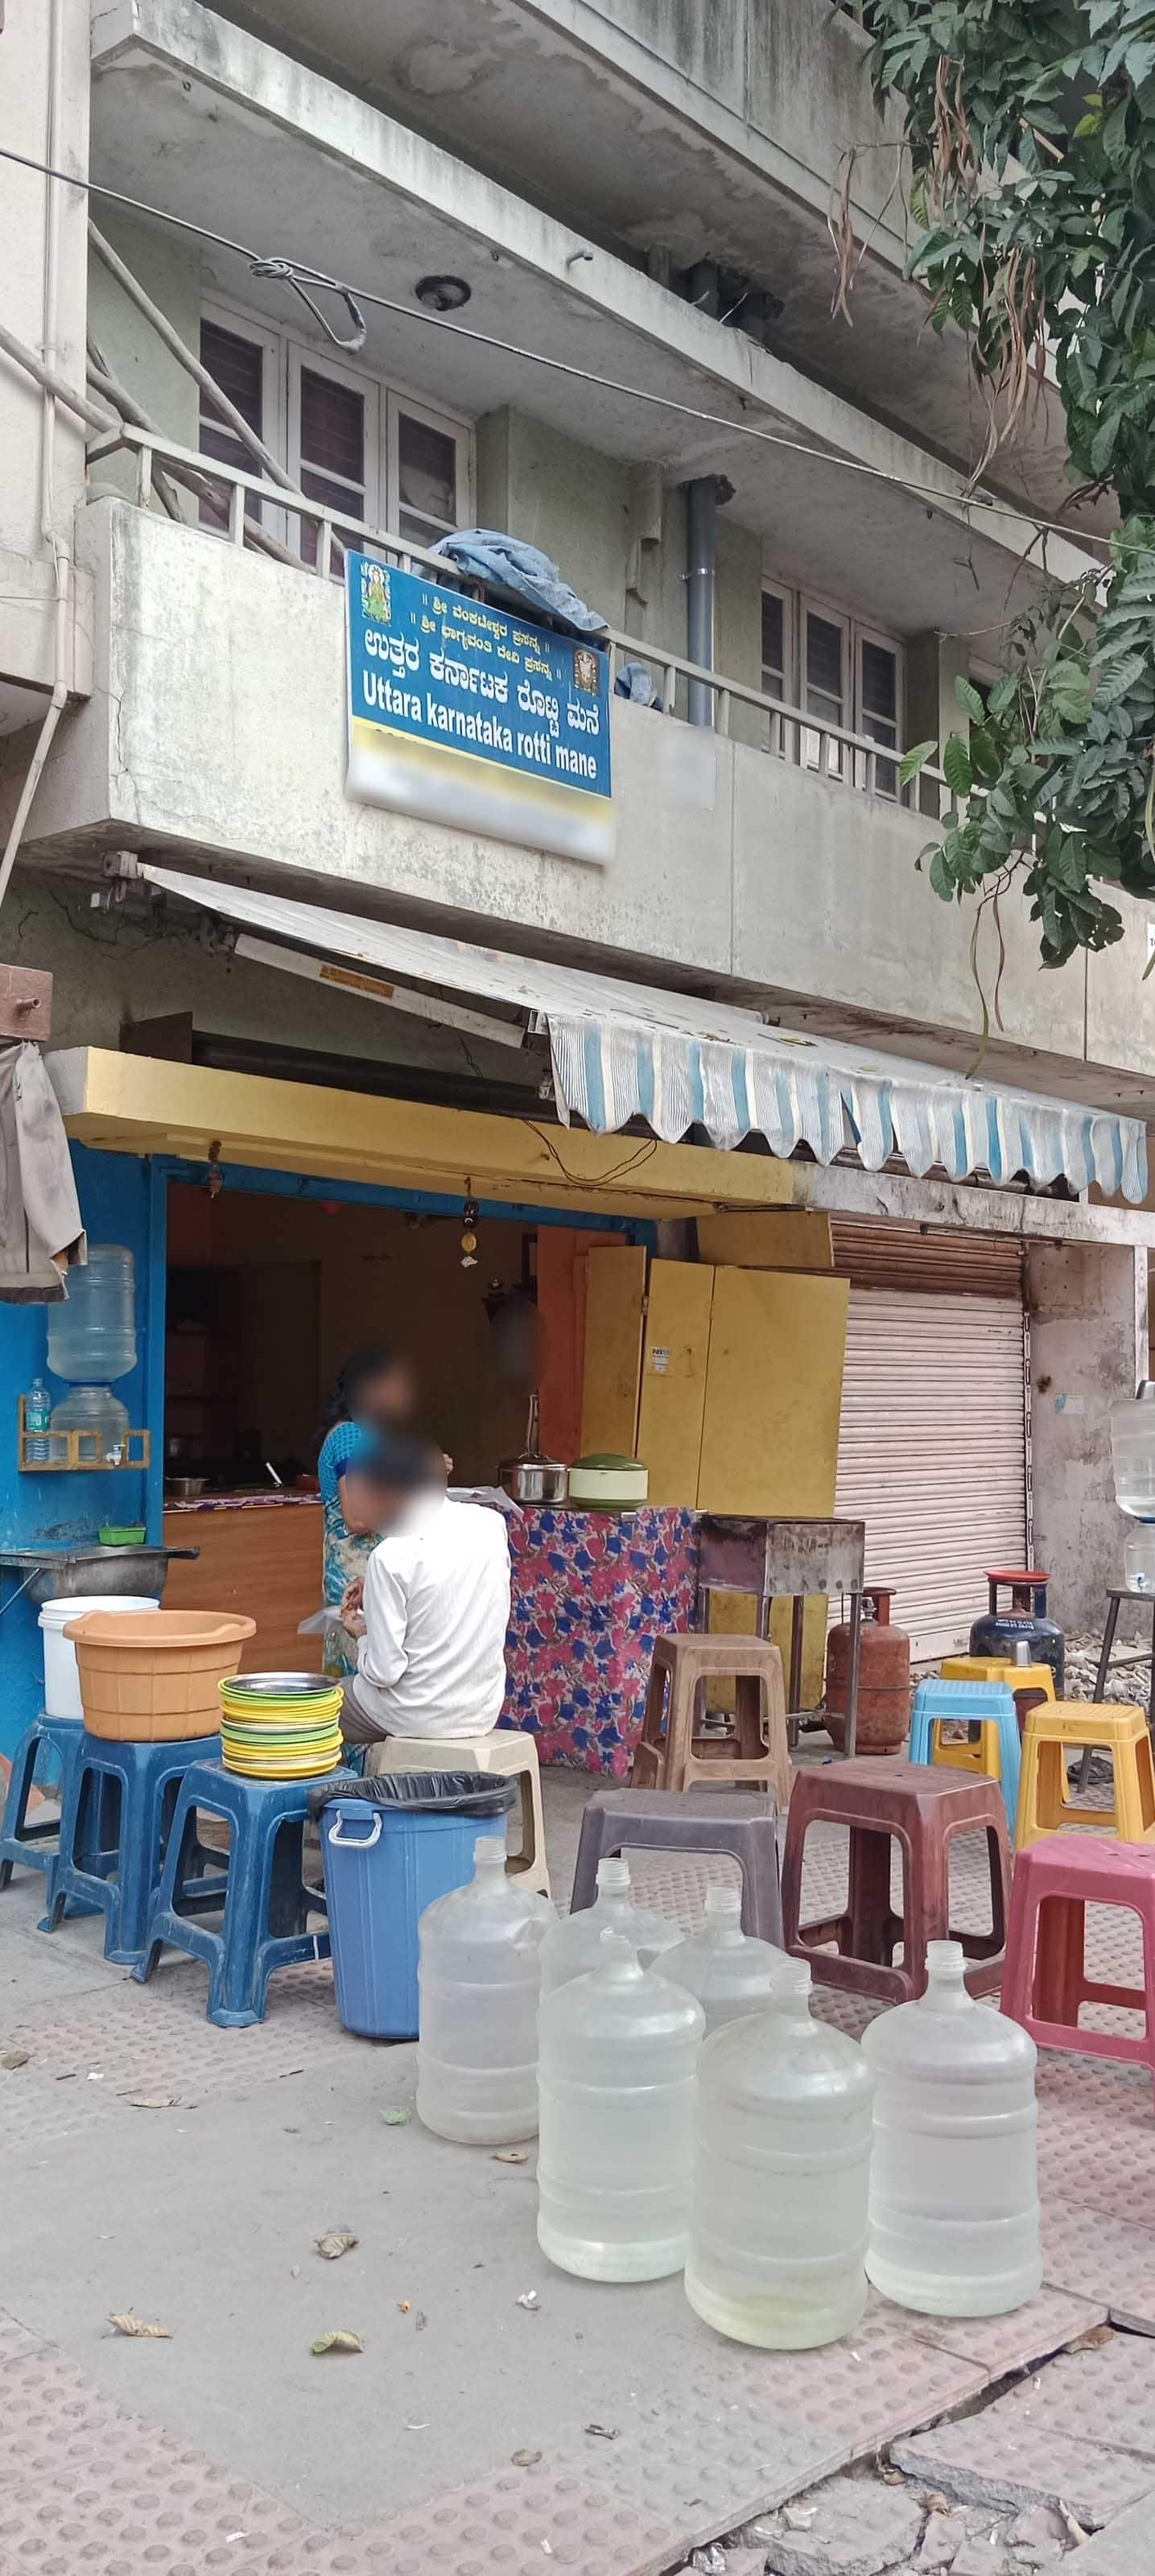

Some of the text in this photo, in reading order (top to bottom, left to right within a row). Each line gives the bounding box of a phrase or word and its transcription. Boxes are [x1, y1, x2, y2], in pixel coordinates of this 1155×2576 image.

[421, 615, 436, 634] ಶ್ರೀ
[497, 646, 520, 664] ದೇವಿ
[525, 656, 553, 681] ಪ್ರಸನ್ನ
[432, 597, 448, 614] ಶ್ರೀ
[452, 605, 508, 639] ವೆಂಕಟೇಶ್ವರ
[513, 630, 541, 654] ಪ್ರಸನ್ನ
[363, 669, 597, 779] Uttara karnataka rotti mane
[365, 630, 600, 738] ಉತ್ತರ ಕರ್ನಾಟಕ ರೊಟ್ಟಿ ಮನೆ
